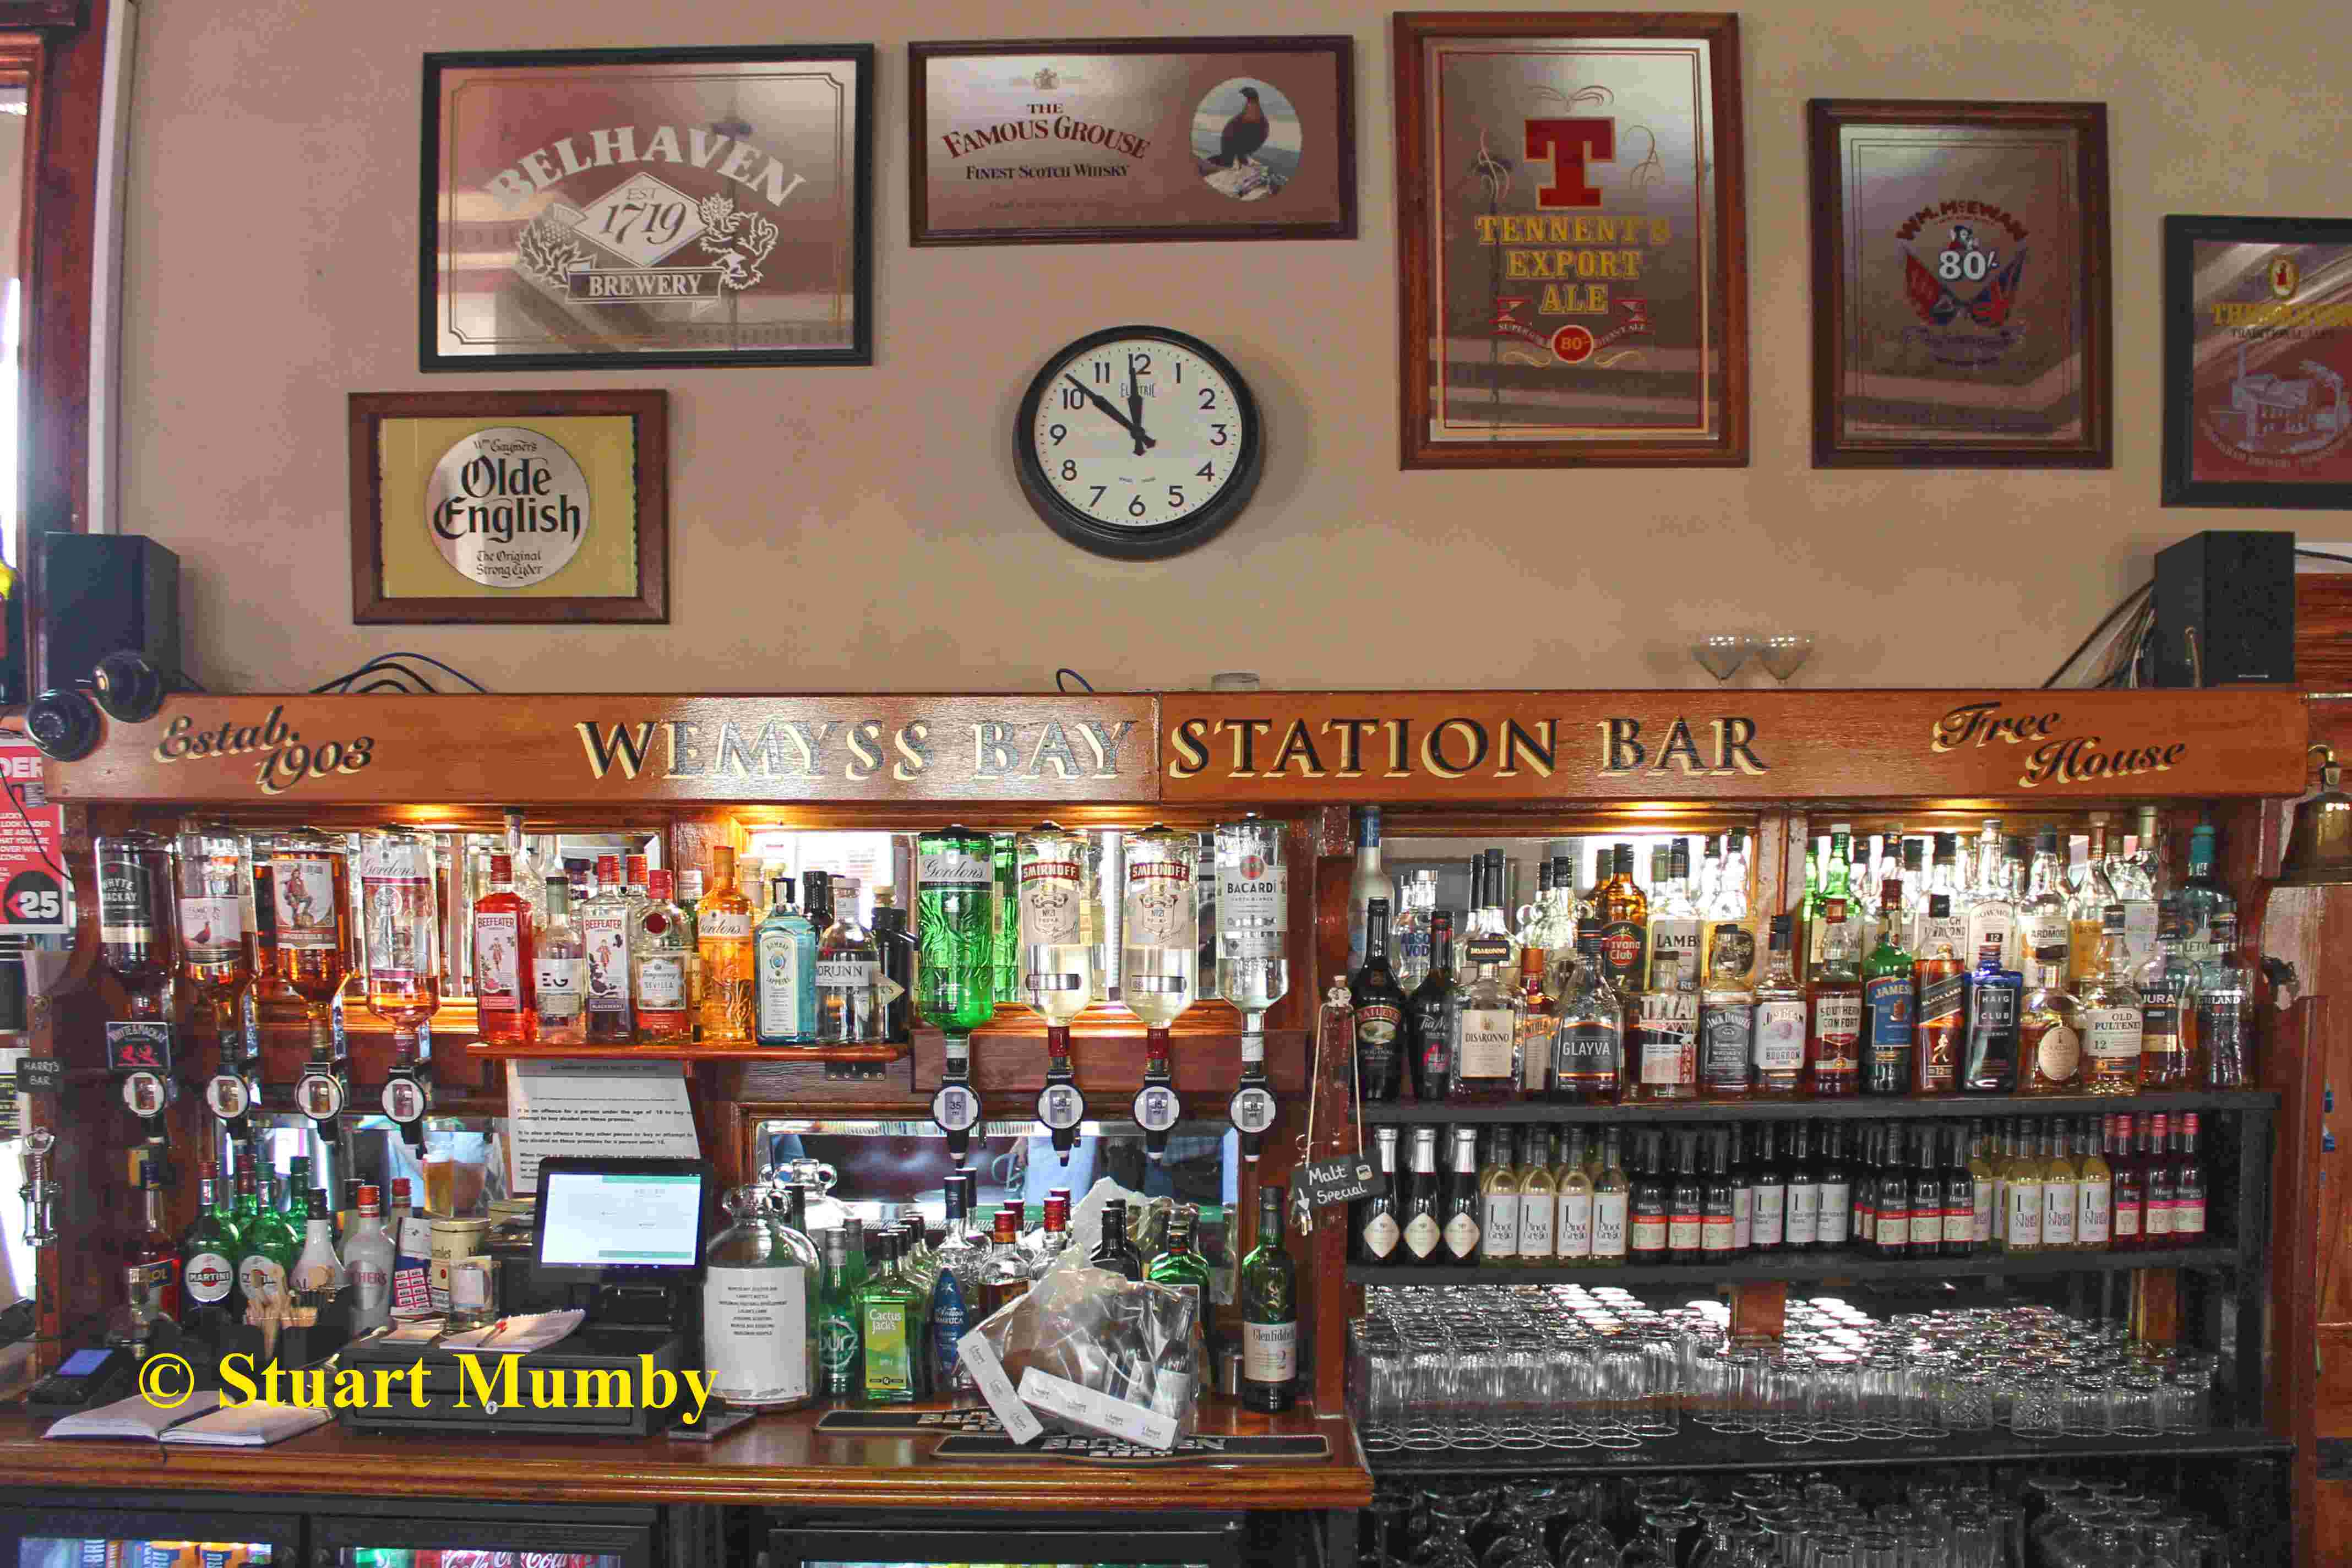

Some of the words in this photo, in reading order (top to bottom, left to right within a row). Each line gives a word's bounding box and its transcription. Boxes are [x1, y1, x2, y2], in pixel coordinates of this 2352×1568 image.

[1027, 102, 1064, 115] THE
[942, 119, 1049, 159] FAMOUS
[1053, 115, 1151, 159] GROUSE
[482, 126, 807, 207] BELHAVEN
[966, 164, 1016, 181] FINEST
[1019, 165, 1071, 178] SCOTCH
[1074, 163, 1130, 178] WHISKY
[627, 187, 657, 200] EST
[600, 200, 687, 244] 1719
[1506, 251, 1643, 279] EXPORT
[589, 274, 701, 297] BREWERY
[1539, 283, 1608, 314] ALE
[1095, 362, 1110, 384] 11
[1128, 353, 1151, 375] 12
[1175, 362, 1181, 384] 1
[1063, 388, 1085, 410] 10
[1120, 383, 1156, 398] ELTRIC
[1199, 388, 1216, 410] 2
[1049, 424, 1067, 445] 9
[1210, 424, 1227, 445] 3
[461, 454, 552, 498] Olde
[1061, 459, 1077, 481] 8
[1195, 461, 1215, 482] 4
[1089, 486, 1108, 507] 7
[1129, 495, 1146, 516] 6
[1168, 486, 1184, 508] 5
[433, 494, 581, 543] English
[476, 549, 494, 562] The
[497, 549, 542, 564] Original
[476, 563, 511, 579] Strong
[153, 705, 301, 763] Estab.
[1931, 700, 2062, 753] Free
[574, 718, 934, 781] WEMYSS
[970, 718, 1140, 781] BAY
[1168, 716, 1561, 779] STATION
[1597, 715, 1773, 777] BAR
[254, 736, 375, 795] 1903
[2018, 736, 2186, 788] House
[1022, 865, 1077, 879] SMIRNOFF
[1131, 864, 1188, 879] SMIRNOFF
[19, 891, 60, 919] 25
[478, 916, 516, 929] BEEFEATER
[585, 918, 622, 930] BEEFEATER
[1610, 950, 1633, 961] Club
[2142, 994, 2176, 1004] JURA
[1823, 1018, 1858, 1028] COMFORT
[1465, 1033, 1510, 1043] DISARONNO
[1562, 1040, 1611, 1057] GLAYVA
[2094, 1040, 2106, 1049] 12
[1766, 1050, 1801, 1060] BOURBON
[949, 1101, 961, 1110] 35
[1309, 1164, 1348, 1186] Malt
[1316, 1182, 1367, 1205] Special
[189, 1272, 230, 1282] MARTINI
[869, 1309, 901, 1322] Cactus
